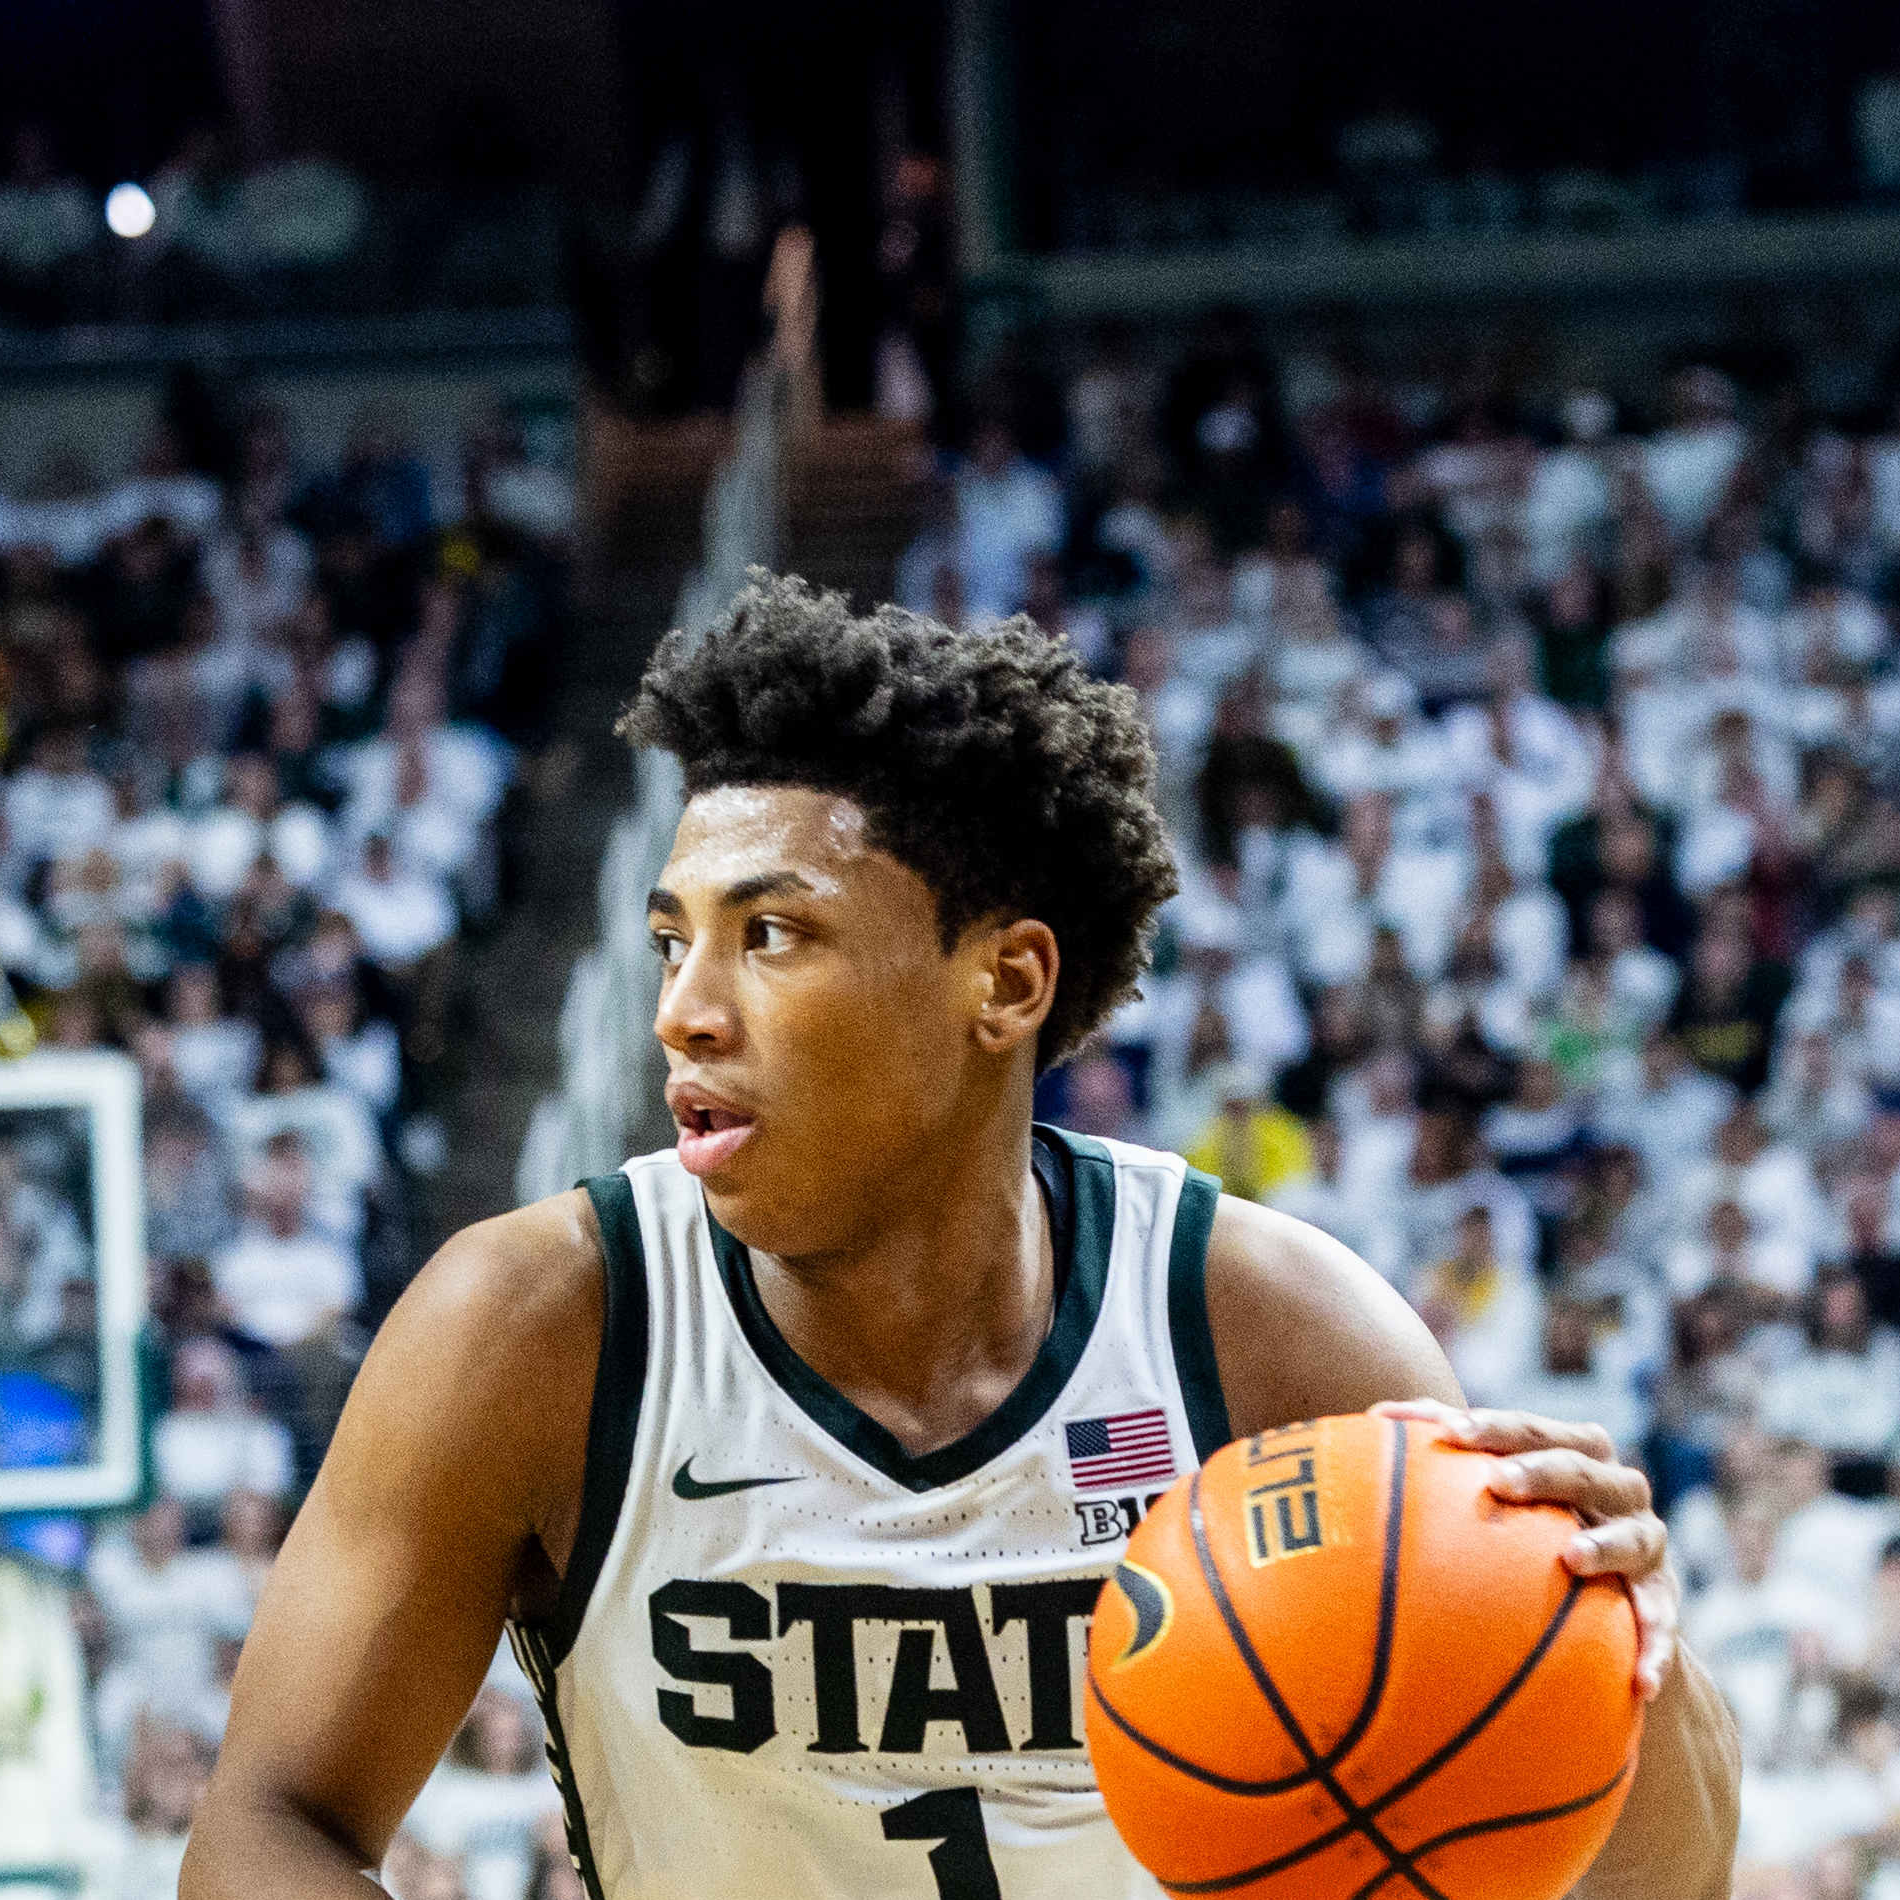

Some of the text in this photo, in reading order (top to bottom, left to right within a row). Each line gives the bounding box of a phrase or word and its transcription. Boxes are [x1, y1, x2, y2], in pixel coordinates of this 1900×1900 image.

[1074, 1492, 1165, 1547] B1
[1249, 1420, 1322, 1558] ELIT
[649, 1578, 1109, 1754] STAT
